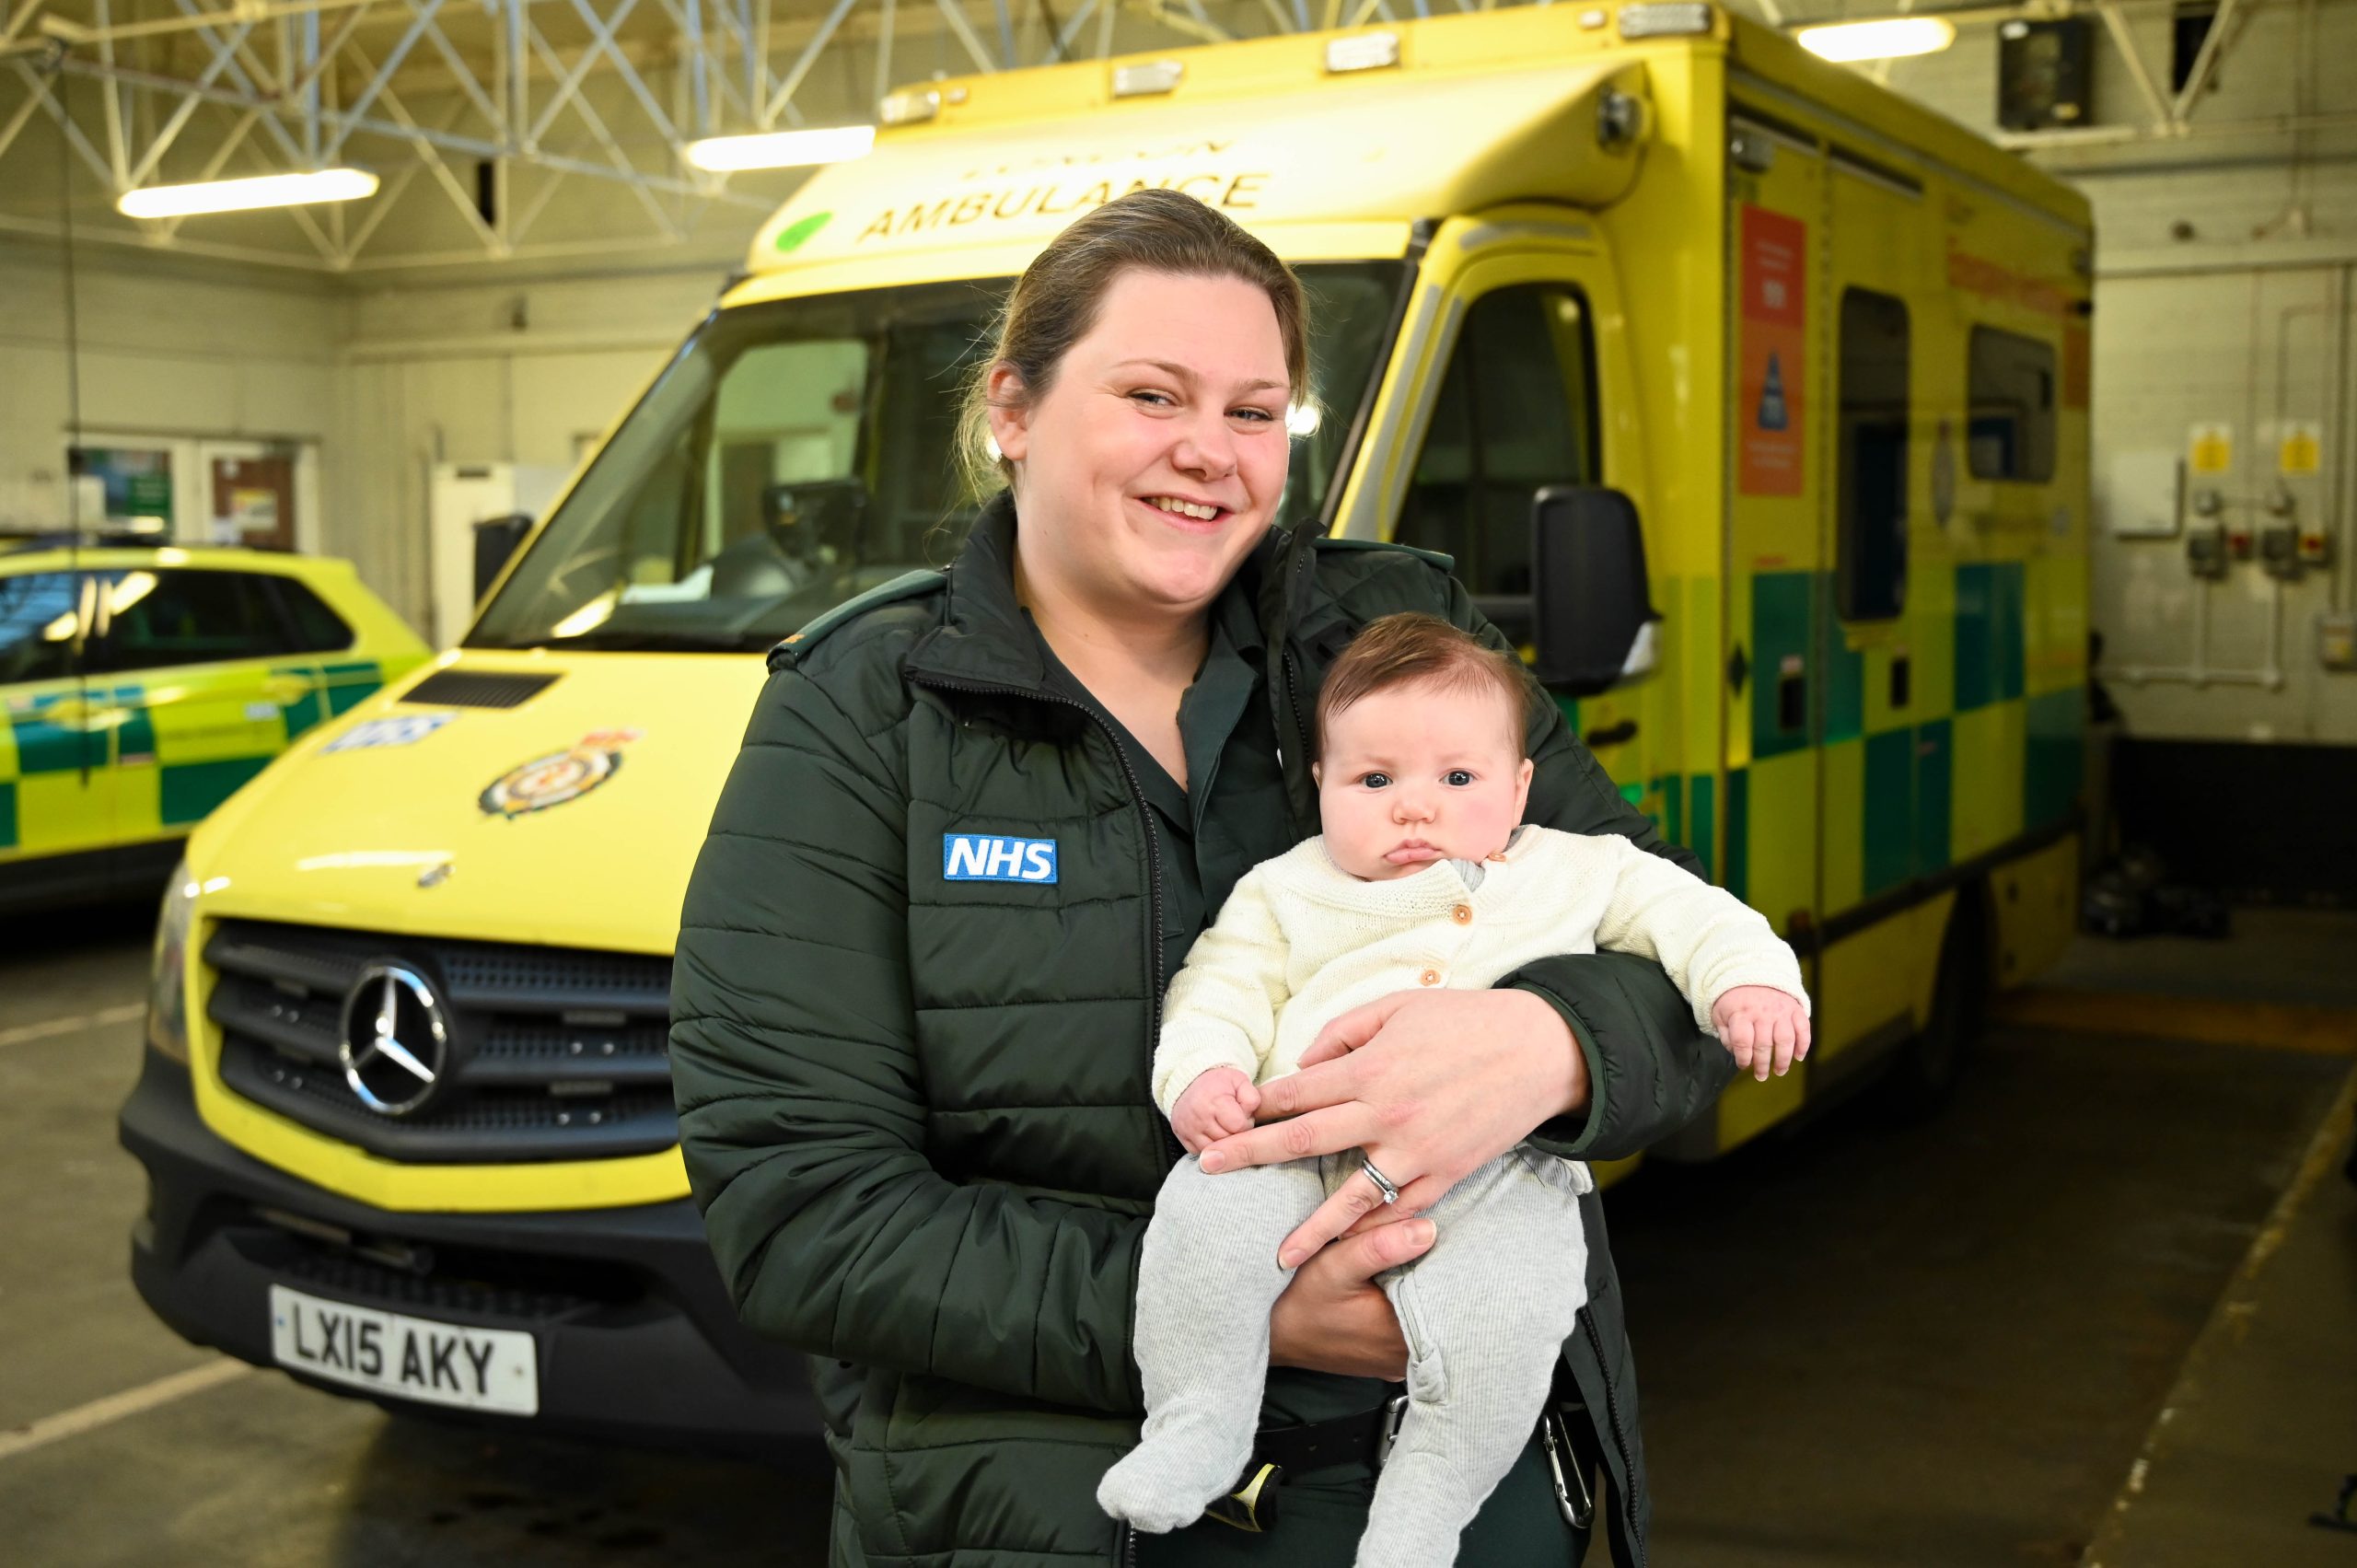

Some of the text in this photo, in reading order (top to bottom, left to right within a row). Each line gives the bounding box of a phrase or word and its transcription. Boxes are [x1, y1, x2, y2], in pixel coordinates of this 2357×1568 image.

[946, 838, 1053, 880] NHS
[293, 1303, 494, 1395] LX15 AKY
